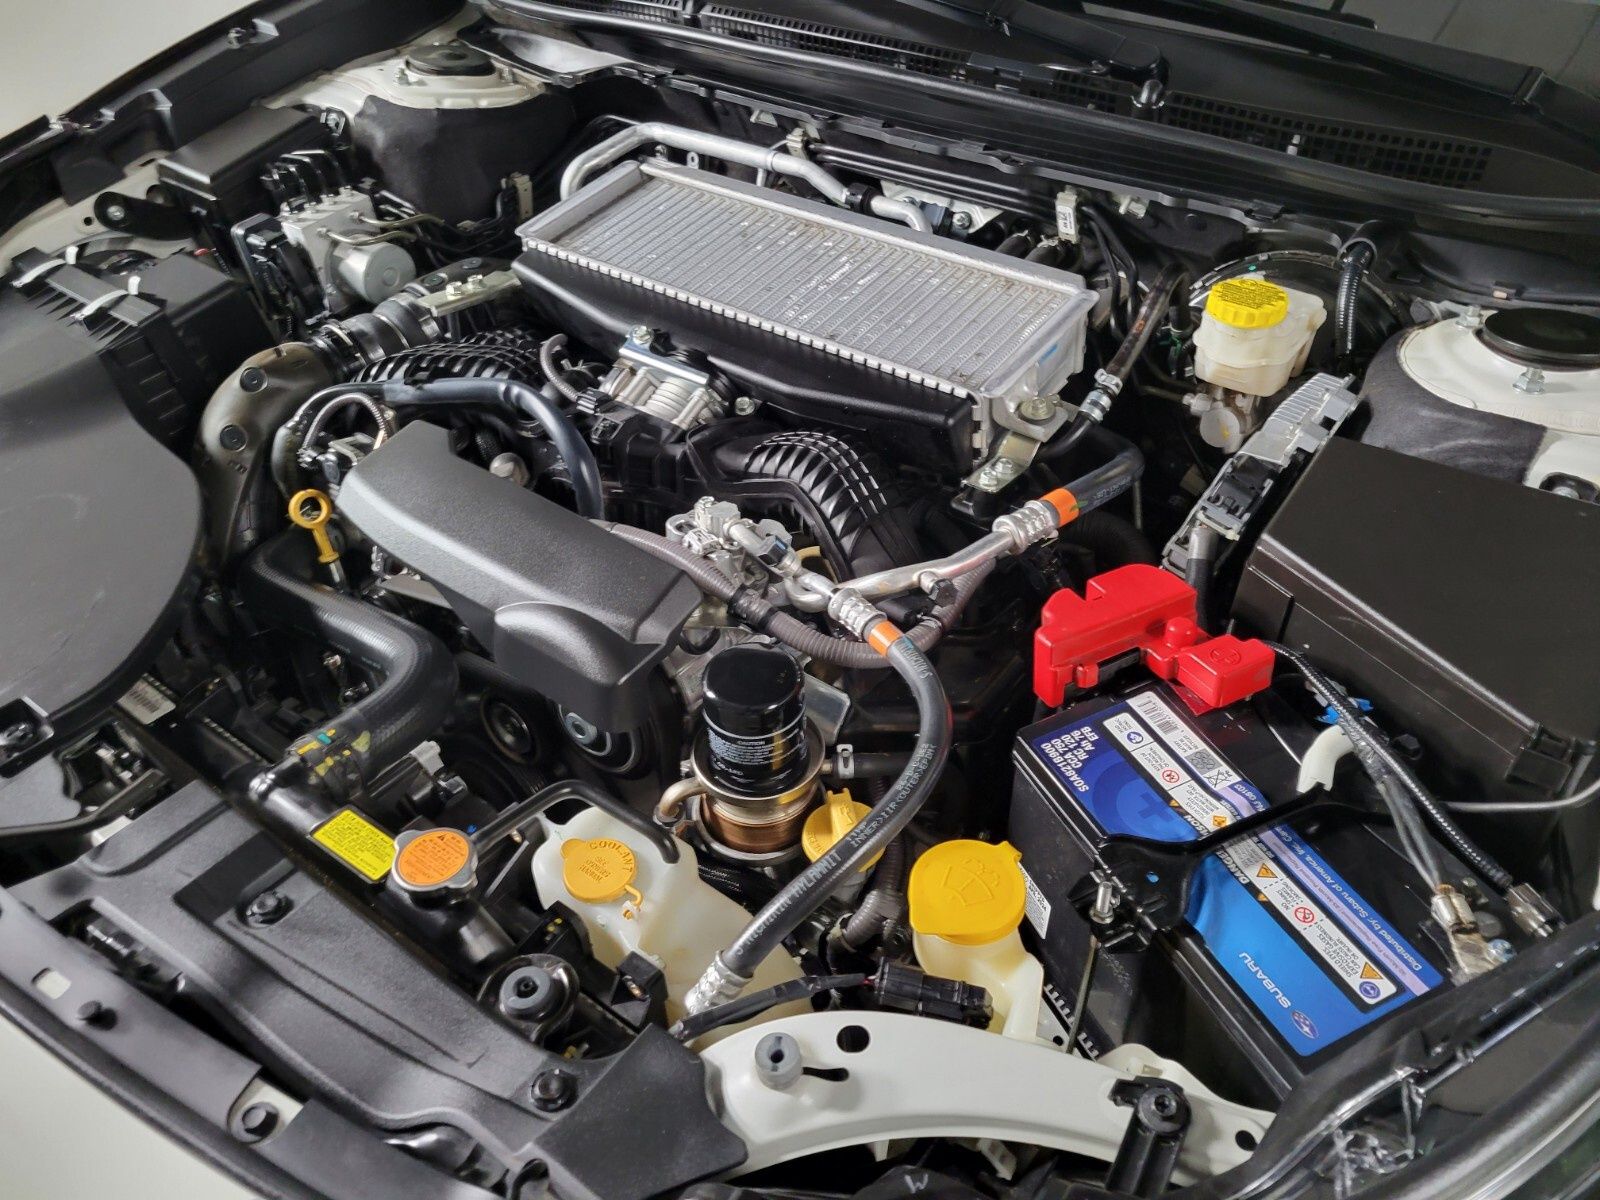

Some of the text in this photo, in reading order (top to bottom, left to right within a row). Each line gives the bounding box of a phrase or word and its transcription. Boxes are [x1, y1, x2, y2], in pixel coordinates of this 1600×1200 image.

[1060, 733, 1088, 760] RC 120
[1070, 729, 1094, 750] Ah 76
[1080, 725, 1099, 740] EFB
[1050, 737, 1081, 769] CCA 750
[589, 840, 633, 872] COOLANT
[1303, 854, 1334, 883] America,
[1339, 890, 1369, 918] Subaru
[1365, 915, 1382, 931] by:
[1378, 928, 1422, 971] Distributed
[1239, 951, 1291, 1008] SUBARU
